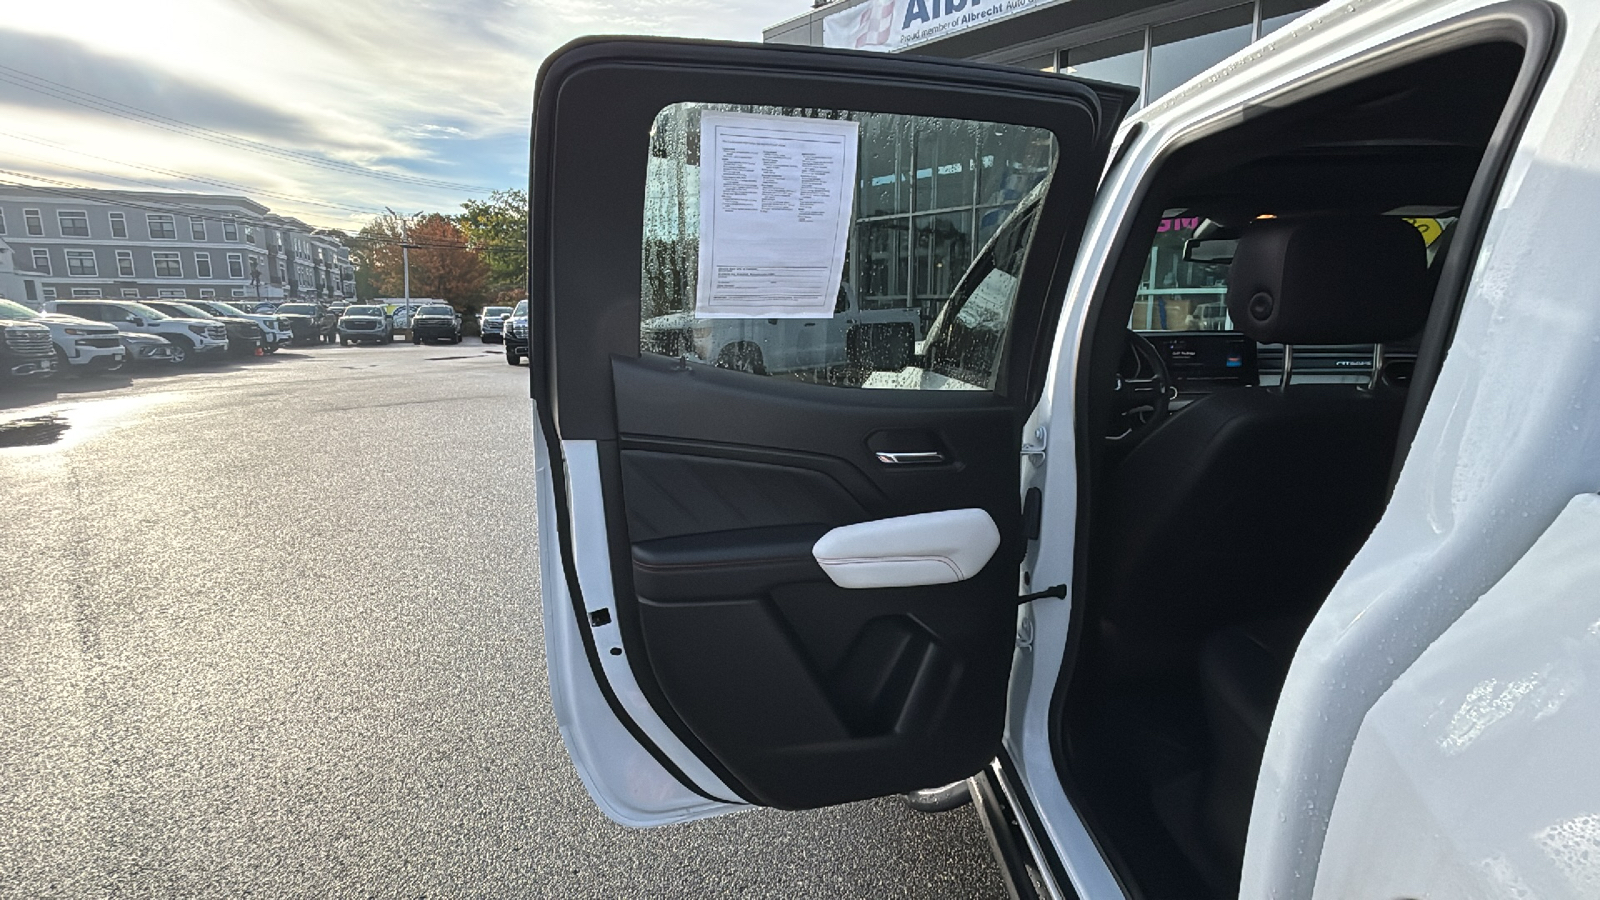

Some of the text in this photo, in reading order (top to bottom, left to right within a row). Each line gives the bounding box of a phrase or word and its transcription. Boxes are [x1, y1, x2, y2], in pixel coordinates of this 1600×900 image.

[900, 30, 920, 43] Proud
[921, 23, 951, 37] member
[951, 16, 961, 28] of
[961, 3, 1002, 25] Albrecht
[902, 0, 981, 30] Alb
